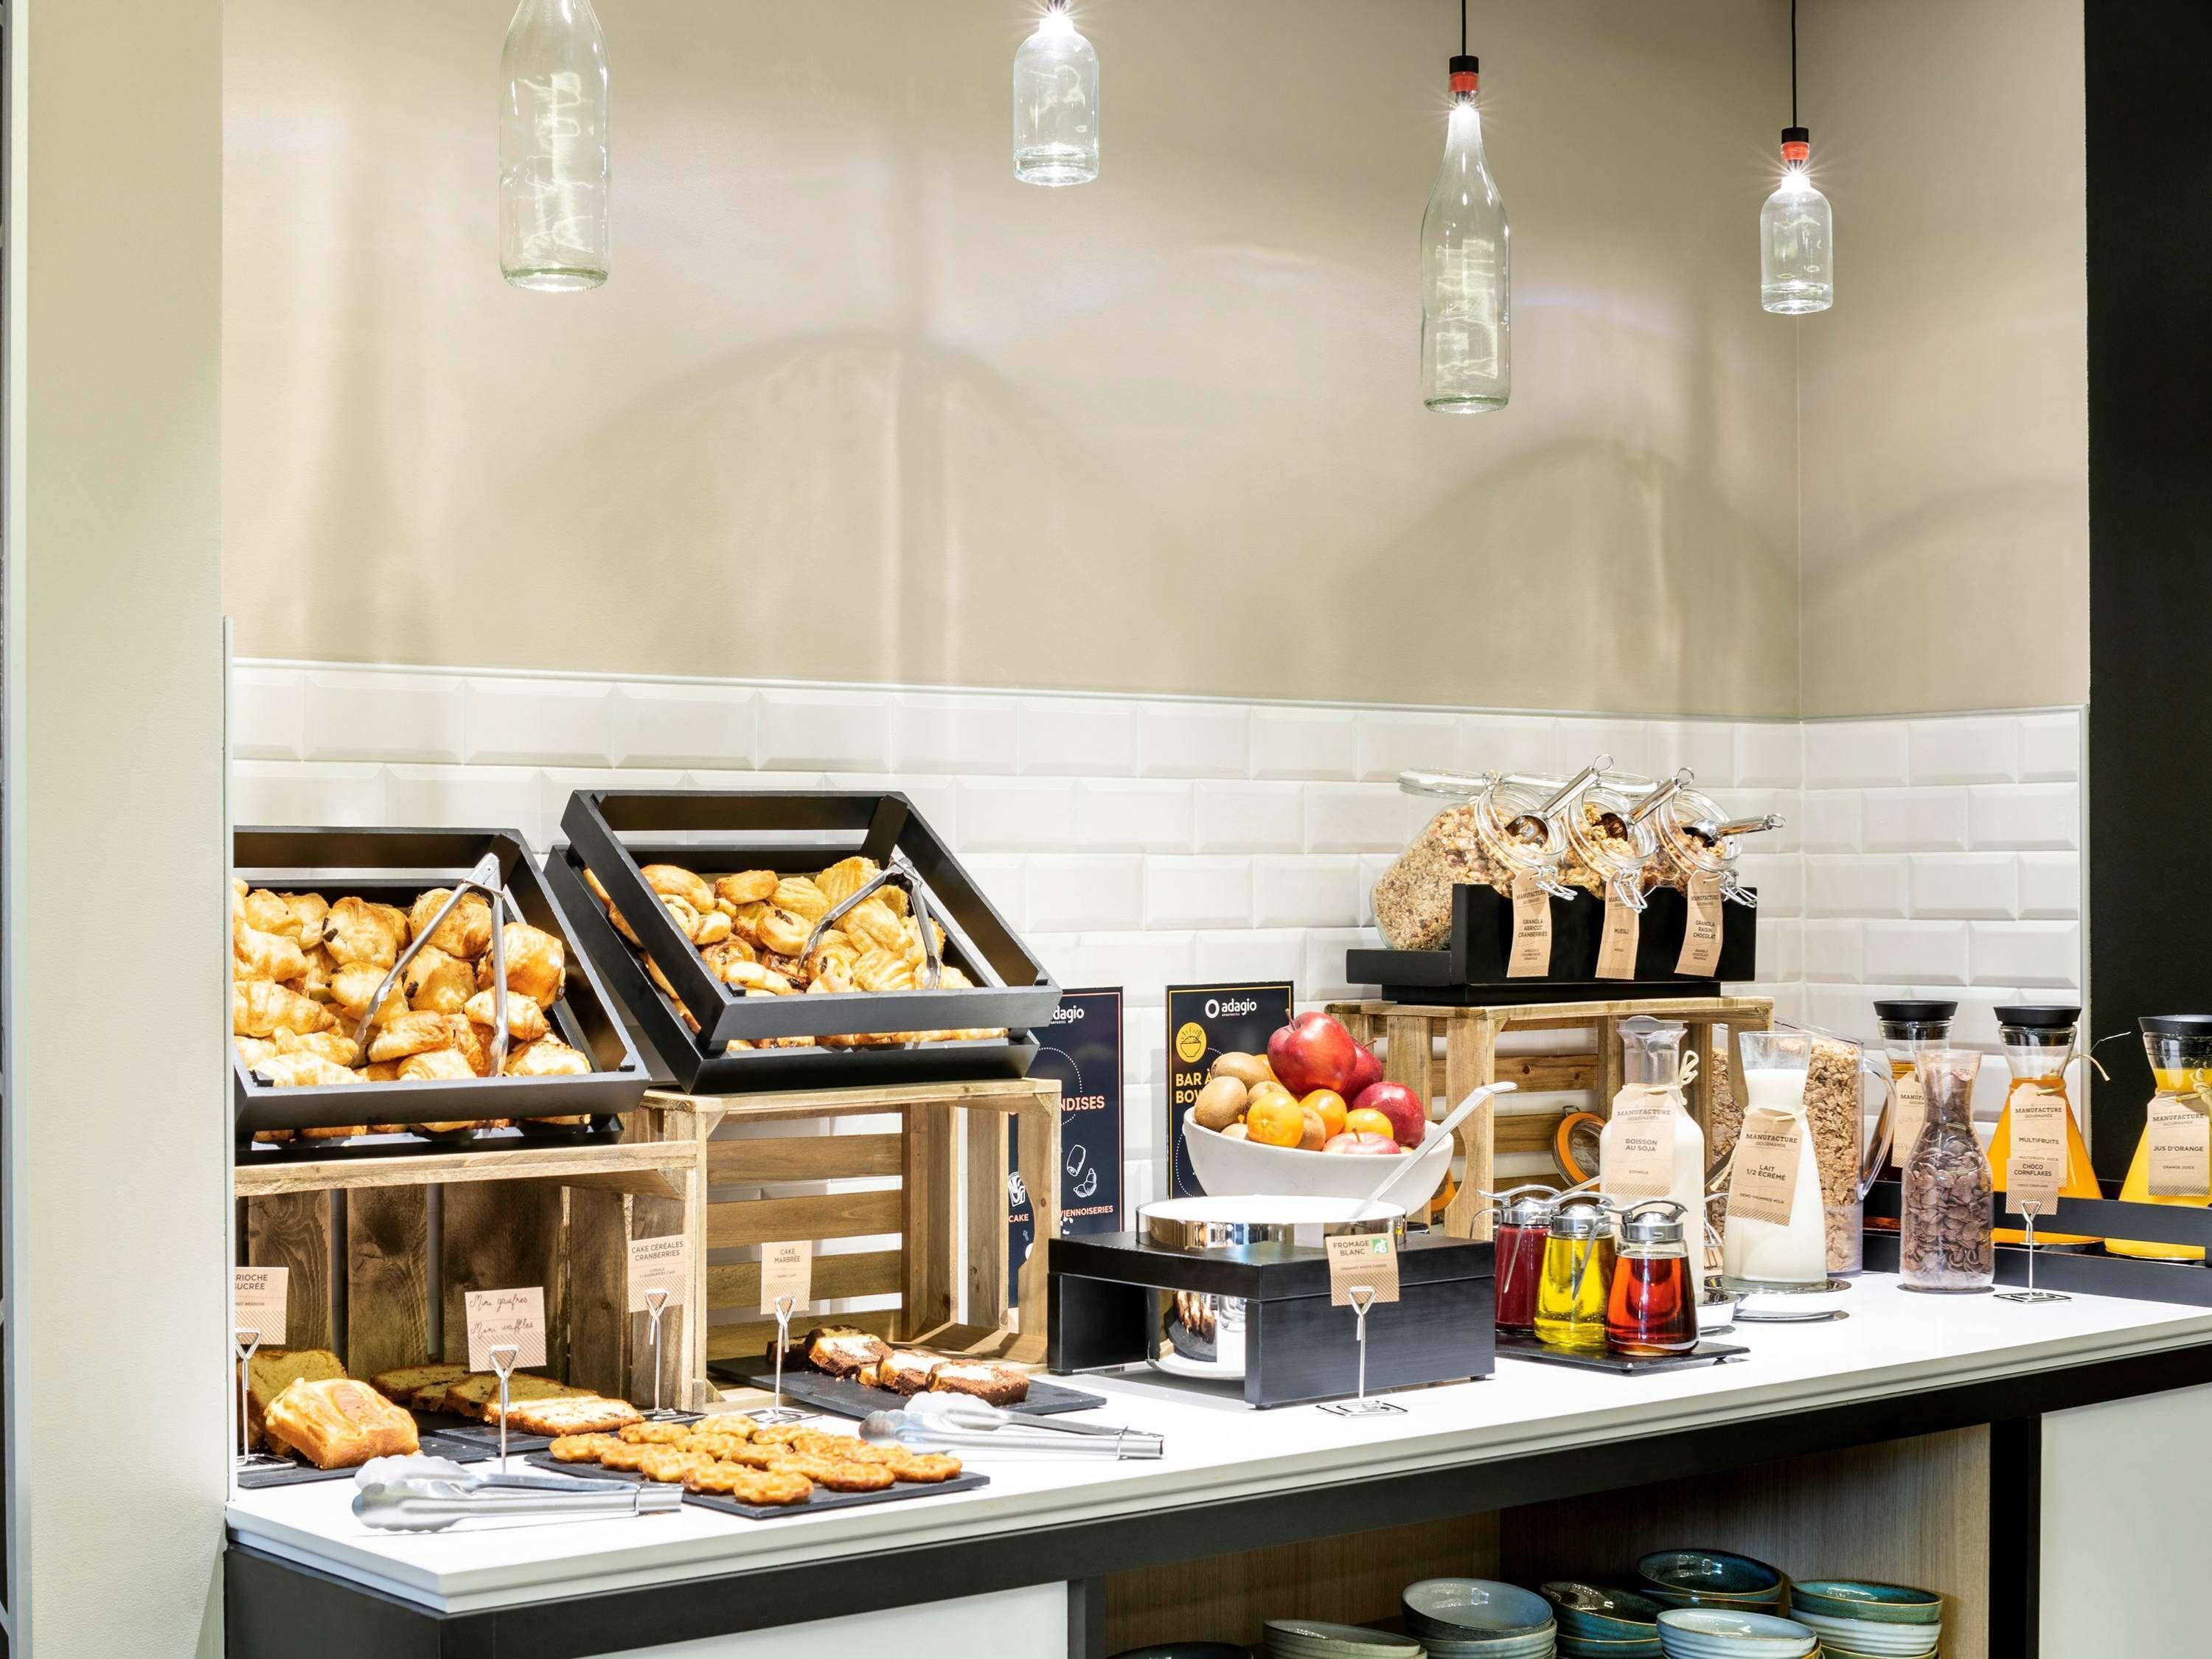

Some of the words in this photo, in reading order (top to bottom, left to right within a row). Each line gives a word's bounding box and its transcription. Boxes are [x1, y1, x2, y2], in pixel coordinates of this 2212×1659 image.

[1051, 1005, 1084, 1023] dagio
[1221, 998, 1257, 1016] adagio
[1176, 1072, 1202, 1087] BAR
[1061, 1095, 1105, 1111] NDISES
[1746, 1134, 1798, 1143] MANUFACTURE
[1009, 1213, 1029, 1222] CAKE
[1333, 1240, 1369, 1249] FROMAGE
[635, 1250, 680, 1261] CRANBERRIES
[496, 1294, 528, 1312] gaufres
